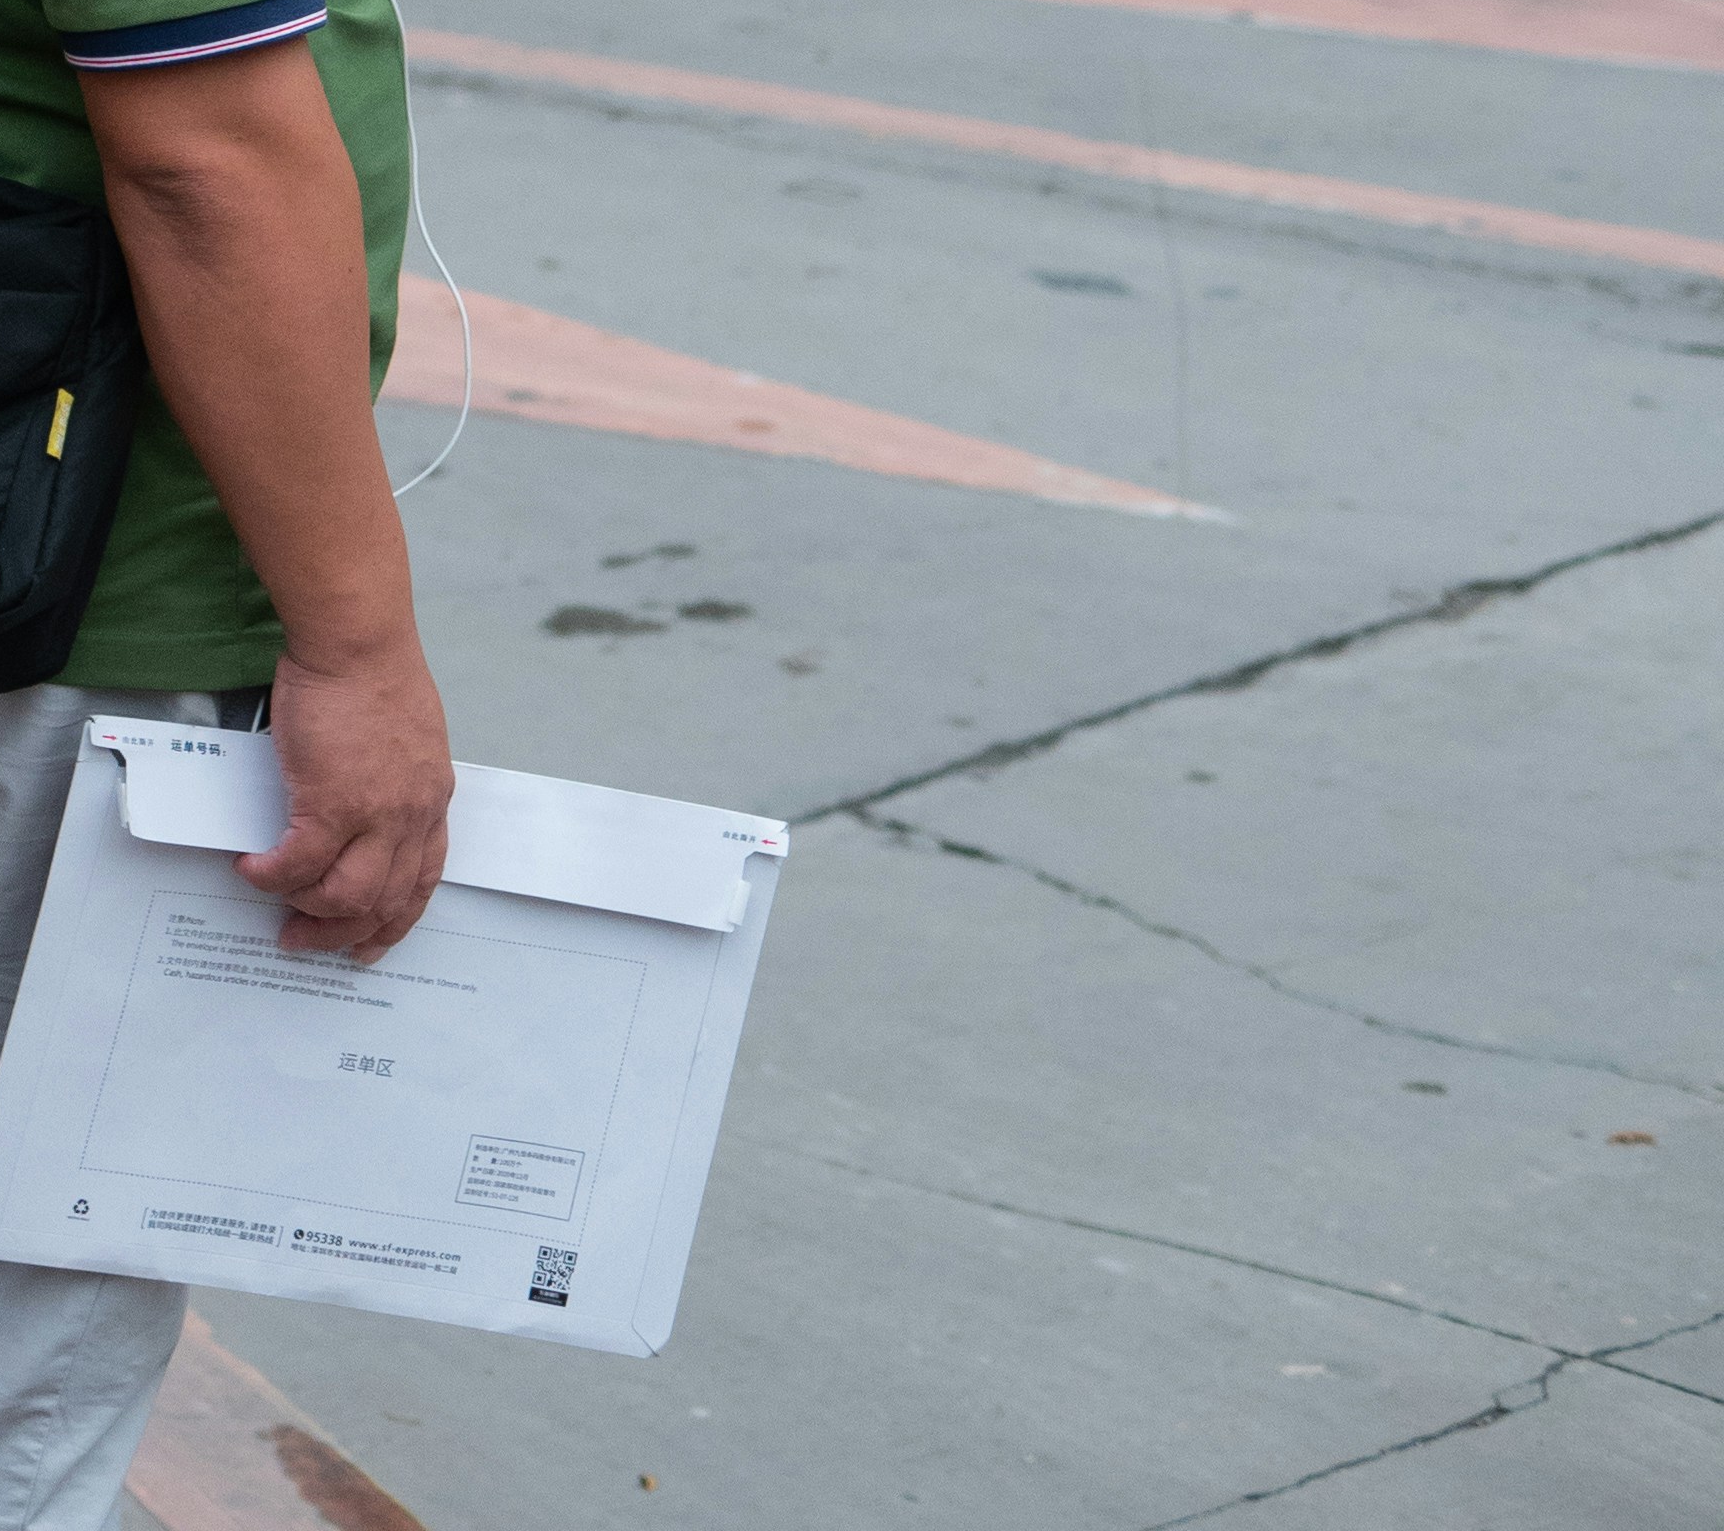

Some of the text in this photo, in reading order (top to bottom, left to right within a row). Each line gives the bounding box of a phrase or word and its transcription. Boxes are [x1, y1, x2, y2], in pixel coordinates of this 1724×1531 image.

[227, 946, 262, 959] applicable
[396, 973, 416, 982] more
[259, 980, 280, 990] other
[281, 984, 320, 997] prohibited
[342, 994, 355, 1002] are
[338, 1052, 395, 1077] 运单区
[306, 1231, 461, 1262] 95338 www.sf-express.com
